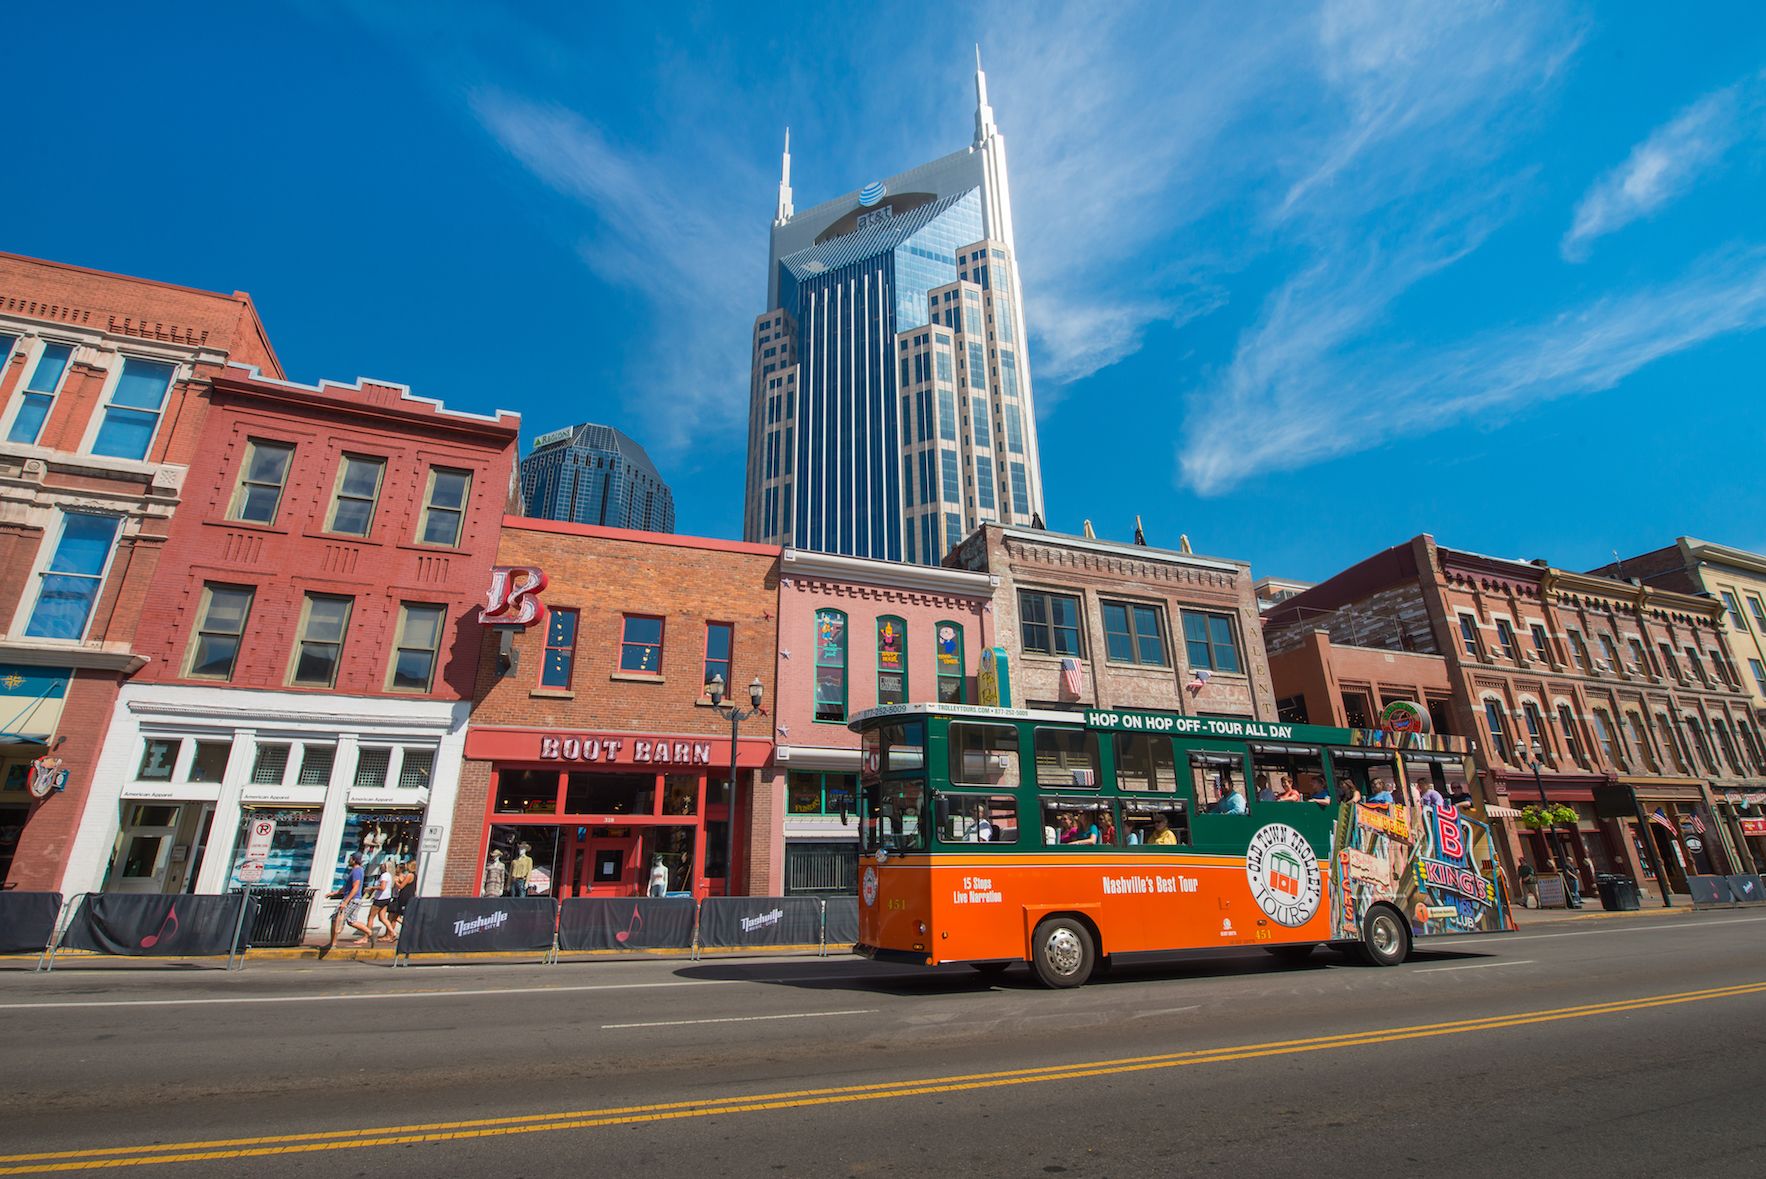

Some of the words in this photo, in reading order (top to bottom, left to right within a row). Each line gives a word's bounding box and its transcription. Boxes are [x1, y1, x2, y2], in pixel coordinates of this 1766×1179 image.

[542, 429, 571, 445] REGIONS
[478, 566, 548, 628] B
[1089, 713, 1119, 726] HOP
[1122, 715, 1142, 729] ON
[1145, 716, 1173, 730] HOP
[1245, 724, 1268, 737] ALL
[1269, 726, 1292, 738] DAY
[540, 735, 624, 762] BOOT
[633, 739, 712, 765] BARN
[1256, 826, 1287, 849] TOWN
[1248, 844, 1264, 873] OLD
[1290, 831, 1321, 898] TROLLEY
[963, 876, 972, 890] 15
[973, 876, 992, 891] Stops
[1102, 876, 1154, 895] Nashville's
[1156, 876, 1177, 893] Best
[1178, 875, 1198, 893] Tour
[1425, 861, 1487, 900] KING'S
[953, 890, 968, 904] Live
[969, 890, 1002, 904] Narration
[1256, 882, 1311, 926] TOURS
[453, 910, 508, 937] Nashville
[740, 908, 783, 932] Nashville
[1256, 929, 1272, 940] 451
